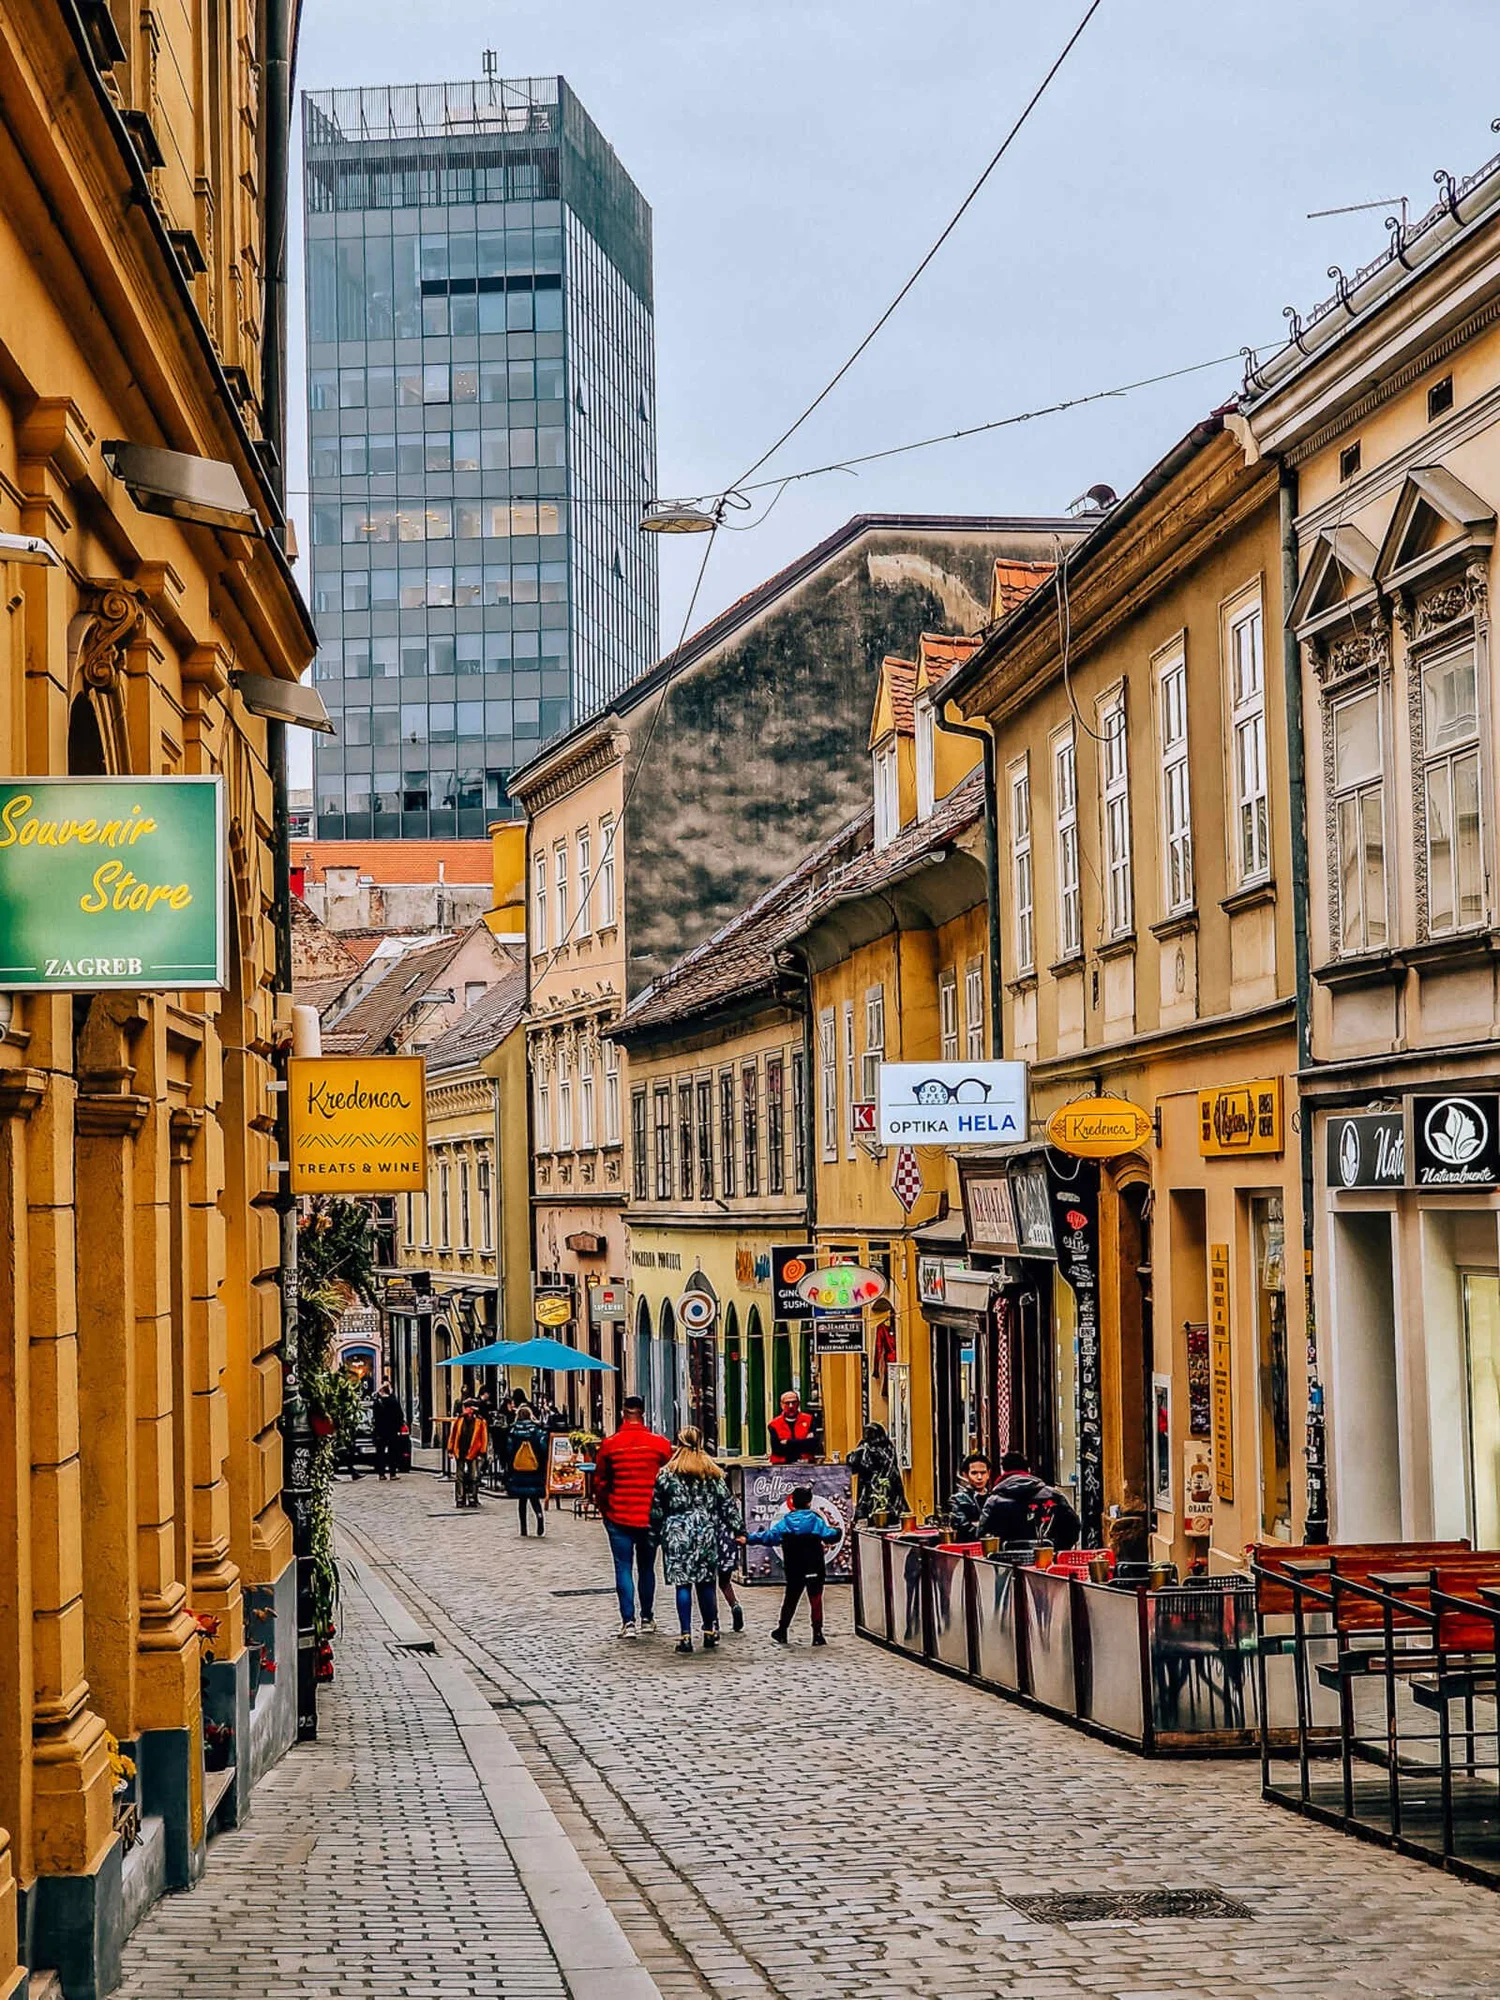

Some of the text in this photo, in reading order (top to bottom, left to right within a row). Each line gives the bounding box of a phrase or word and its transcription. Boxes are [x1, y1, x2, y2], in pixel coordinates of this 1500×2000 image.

[0, 795, 157, 848] Souvenir
[80, 860, 193, 913] Store
[44, 958, 143, 977] ZAGREB
[306, 1080, 411, 1120] Kredenca
[889, 1120, 949, 1134] OPTIKA
[958, 1114, 1017, 1132] HELA
[1073, 1117, 1130, 1139] Kredenca
[297, 1160, 420, 1175] TREATS & WINE
[754, 1476, 796, 1501] Coffee
